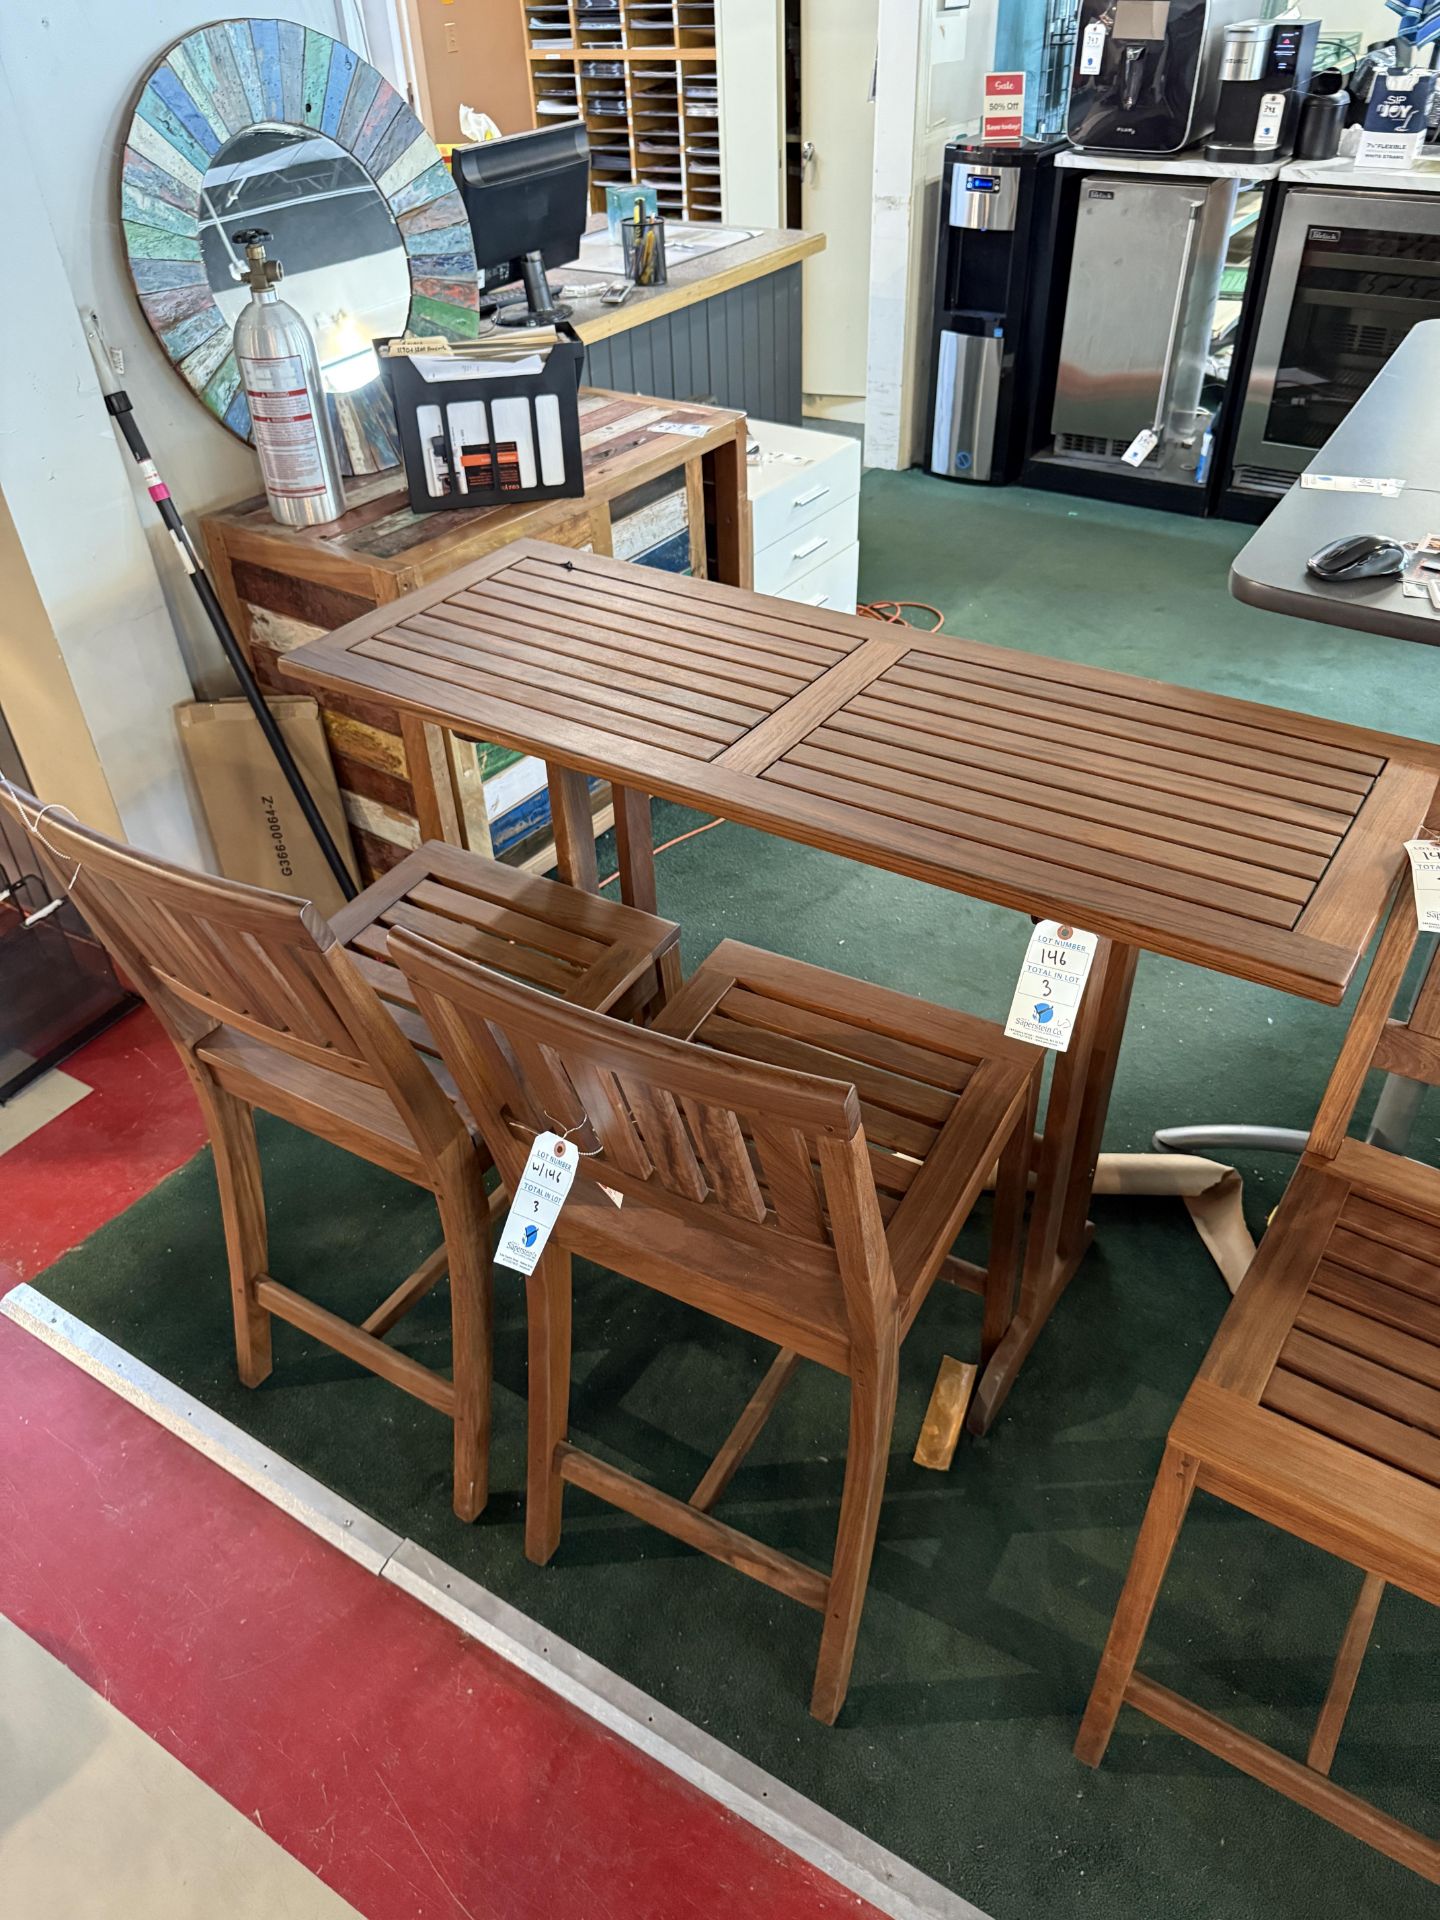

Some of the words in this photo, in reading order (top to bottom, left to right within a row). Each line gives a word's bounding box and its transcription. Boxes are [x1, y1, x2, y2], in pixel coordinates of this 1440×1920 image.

[994, 80, 1015, 90] Sale
[989, 103, 1005, 111] 50%
[1007, 102, 1019, 111] Off
[1387, 95, 1407, 104] SIP
[986, 123, 1000, 131] Save
[1001, 123, 1021, 131] today!
[262, 795, 293, 877] G366-0064-Z
[1038, 935, 1053, 944] LOT
[1055, 940, 1087, 952] NUMBER
[1041, 948, 1067, 967] 146
[1027, 965, 1052, 977] TOTAL
[1054, 972, 1063, 980] IN
[1065, 975, 1080, 985] LOT
[1042, 979, 1052, 997] 3
[1015, 1017, 1052, 1034] Saperstein
[1052, 1025, 1064, 1037] Co.
[536, 1150, 549, 1160] LOT
[549, 1155, 572, 1171] NUMBER
[524, 1182, 543, 1196] TOTAL
[544, 1191, 551, 1199] IN
[551, 1195, 563, 1205] LOT
[533, 1200, 540, 1213] 3
